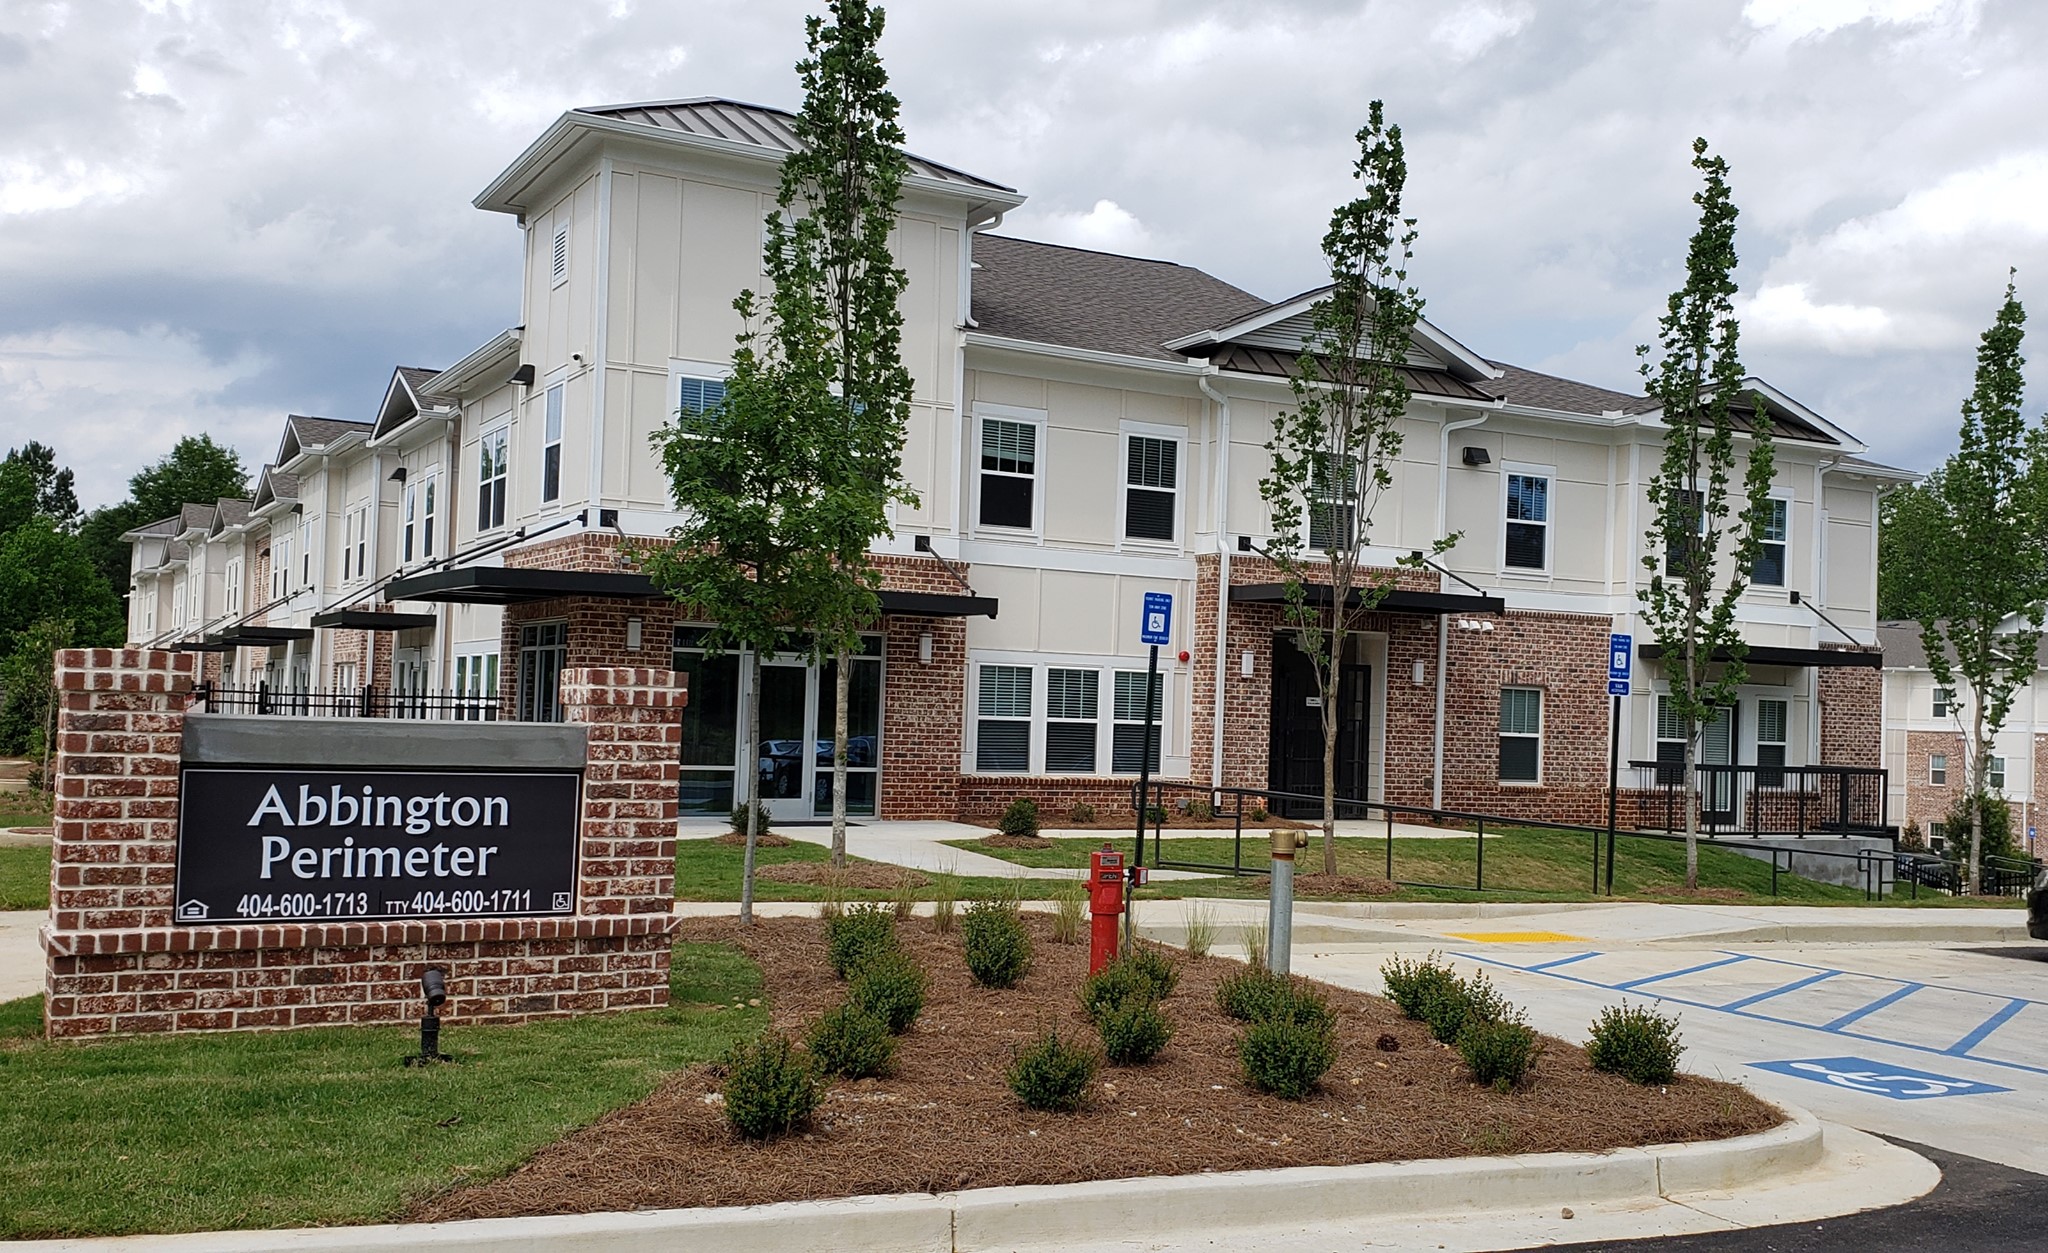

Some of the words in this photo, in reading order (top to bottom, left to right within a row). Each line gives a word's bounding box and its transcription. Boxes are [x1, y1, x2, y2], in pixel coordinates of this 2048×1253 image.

[246, 783, 509, 834] Abbington
[259, 836, 498, 880] Perimeter
[236, 892, 369, 918] 404-600-1713
[385, 900, 409, 914] TTY
[411, 889, 531, 914] 404-600-1711
